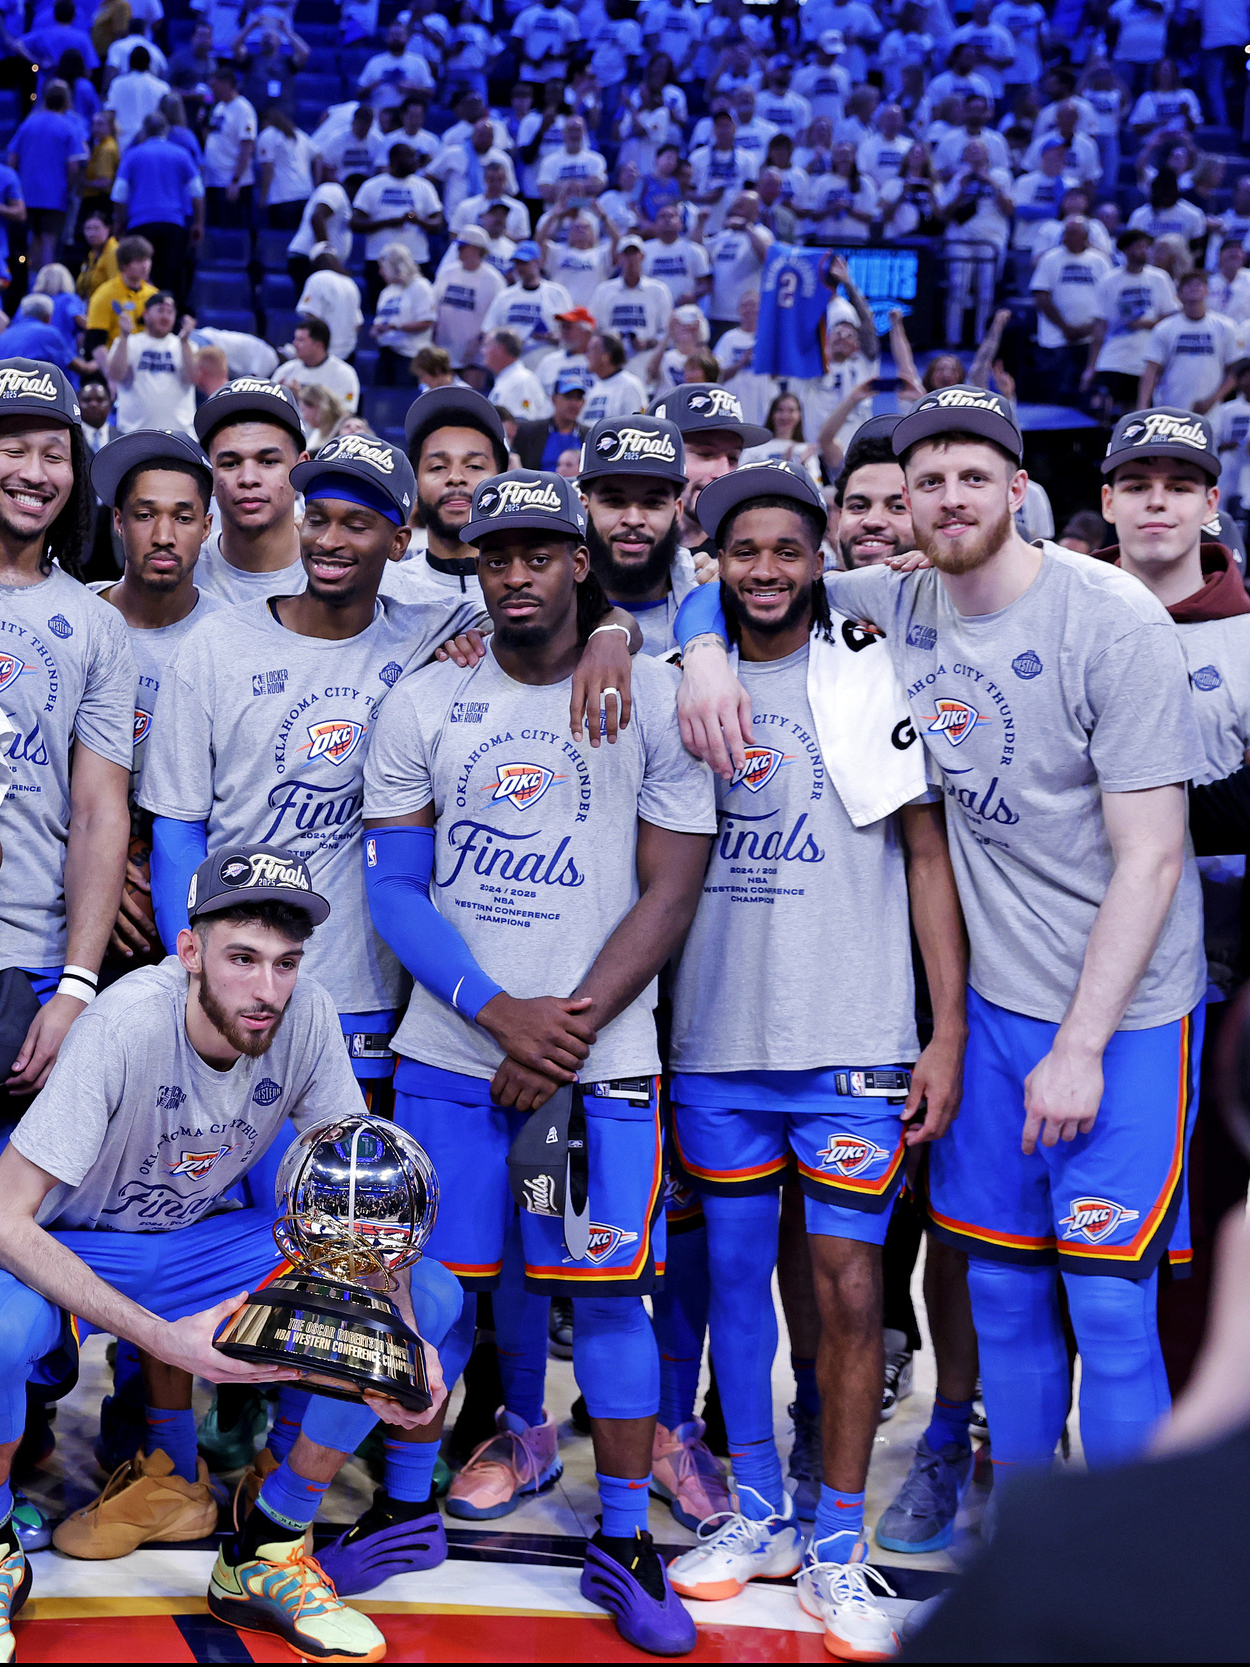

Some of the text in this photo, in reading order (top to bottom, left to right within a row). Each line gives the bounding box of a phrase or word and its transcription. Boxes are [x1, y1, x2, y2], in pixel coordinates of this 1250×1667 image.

[778, 270, 798, 309] 2
[2, 389, 18, 399] 2025
[1133, 414, 1208, 450] Finals
[324, 435, 395, 475] Finals
[608, 428, 676, 463] Finals
[623, 452, 639, 461] 2025
[488, 480, 562, 518] Finals
[504, 504, 520, 513] 2025
[49, 620, 73, 637] WESTERN
[31, 637, 58, 713] THUNDER
[266, 668, 289, 683] LOCKER
[267, 681, 285, 695] ROOM
[464, 712, 483, 724] ROOM
[466, 702, 490, 714] LOCKER
[953, 663, 984, 682] CITY
[986, 681, 1015, 766] THUNDER
[275, 693, 319, 774] OKLAHOMA
[325, 687, 360, 700] CITY
[933, 710, 969, 731] OKC
[309, 727, 352, 759] OKC
[753, 713, 825, 801] CITY THUNDER
[456, 729, 591, 823] OKLAHOMA CITY THUNDER
[493, 772, 542, 800] OKC
[435, 820, 585, 887] Finals
[239, 853, 309, 891] Finals
[703, 885, 748, 893] WESTERN
[493, 896, 515, 906] NBA
[494, 907, 561, 921] CONFERENCE
[253, 1086, 282, 1101] WESTERN
[831, 1145, 865, 1163] OKC
[1072, 1208, 1110, 1229] OKC
[305, 1320, 336, 1340] OSCAR
[274, 1328, 291, 1342] NBA
[292, 1331, 332, 1351] WESTERN
[332, 1341, 382, 1366] CONFERENCE
